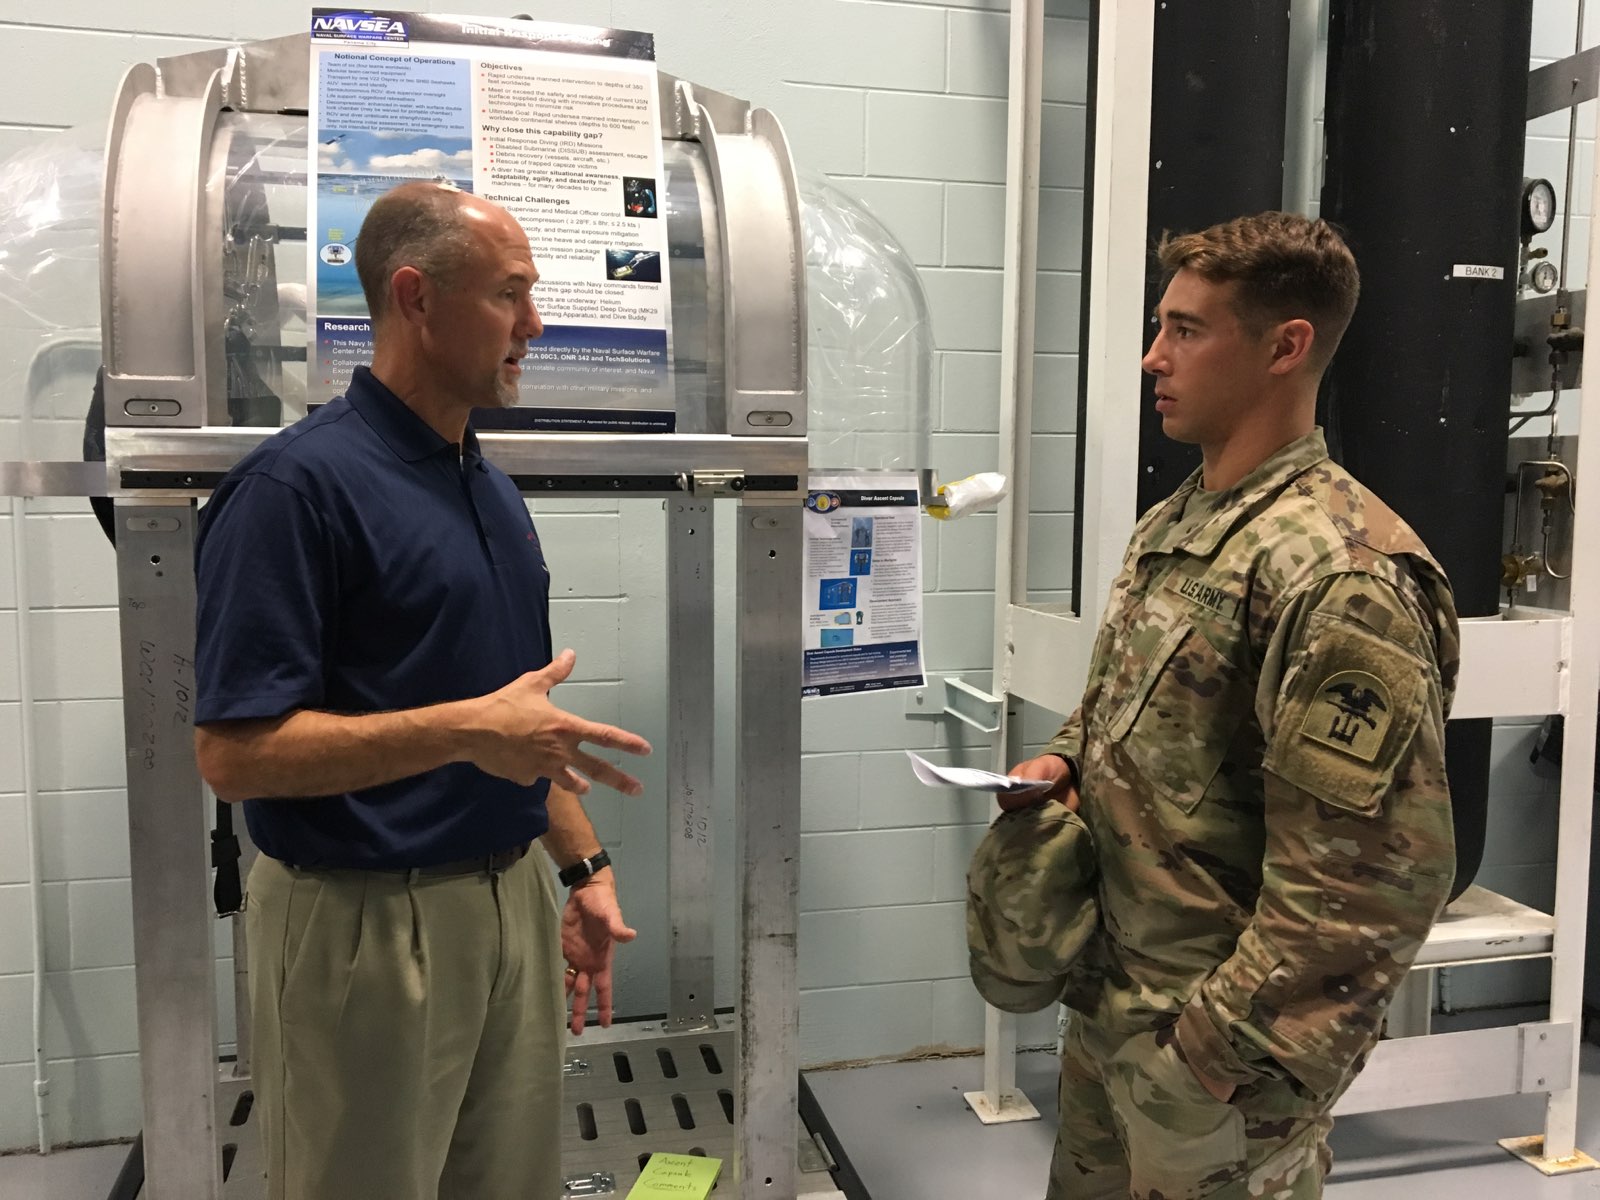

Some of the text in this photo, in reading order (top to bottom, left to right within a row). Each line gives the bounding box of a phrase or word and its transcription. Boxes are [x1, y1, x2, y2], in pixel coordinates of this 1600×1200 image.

[314, 18, 405, 34] NAVSEA
[334, 53, 367, 61] Notional
[369, 55, 401, 64] Concept
[413, 57, 456, 66] Operations
[481, 63, 522, 72] Objectives
[506, 74, 534, 82] undersea
[561, 78, 595, 86] intervention
[603, 81, 623, 89] depths
[512, 88, 534, 96] exceed
[545, 91, 564, 99] safety
[577, 93, 604, 102] reliability
[488, 99, 526, 108] technologies
[511, 95, 536, 104] supplied
[538, 97, 555, 105] diving
[570, 99, 600, 107] innovative
[601, 101, 634, 111] procedures
[489, 108, 640, 124] Ultimate Rapid undersea manned intervention
[489, 114, 519, 122] worldwide
[577, 121, 600, 129] (depths
[482, 125, 500, 133] Why
[542, 129, 581, 138] capability
[582, 131, 603, 140] gap?
[507, 137, 537, 146] Response
[538, 139, 558, 147] Diving
[559, 140, 575, 148] (IRD)
[523, 145, 556, 153] Submarine
[557, 147, 586, 156] (DISSUB)
[587, 149, 625, 159] assessment,
[527, 160, 551, 168] trapped
[552, 161, 575, 170] capsize
[491, 173, 530, 182] adaptability,
[532, 175, 553, 183] agility,
[568, 177, 596, 186] dexterity
[526, 168, 548, 176] greater
[584, 173, 620, 181] awareness,
[484, 193, 570, 206] Technical Challenges
[507, 206, 539, 214] Supervisor
[610, 230, 639, 238] mitigation
[587, 238, 643, 248] catenary mitigation
[575, 247, 600, 255] package
[568, 254, 595, 262] reliability
[1466, 267, 1497, 277] BANK 2
[572, 304, 599, 313] Supplied
[618, 306, 637, 314] Diving
[563, 311, 598, 319] Apparatus),
[324, 322, 370, 331] Research
[549, 346, 571, 354] directly
[540, 353, 559, 361] 00C3,
[605, 356, 651, 364] TechSolutions
